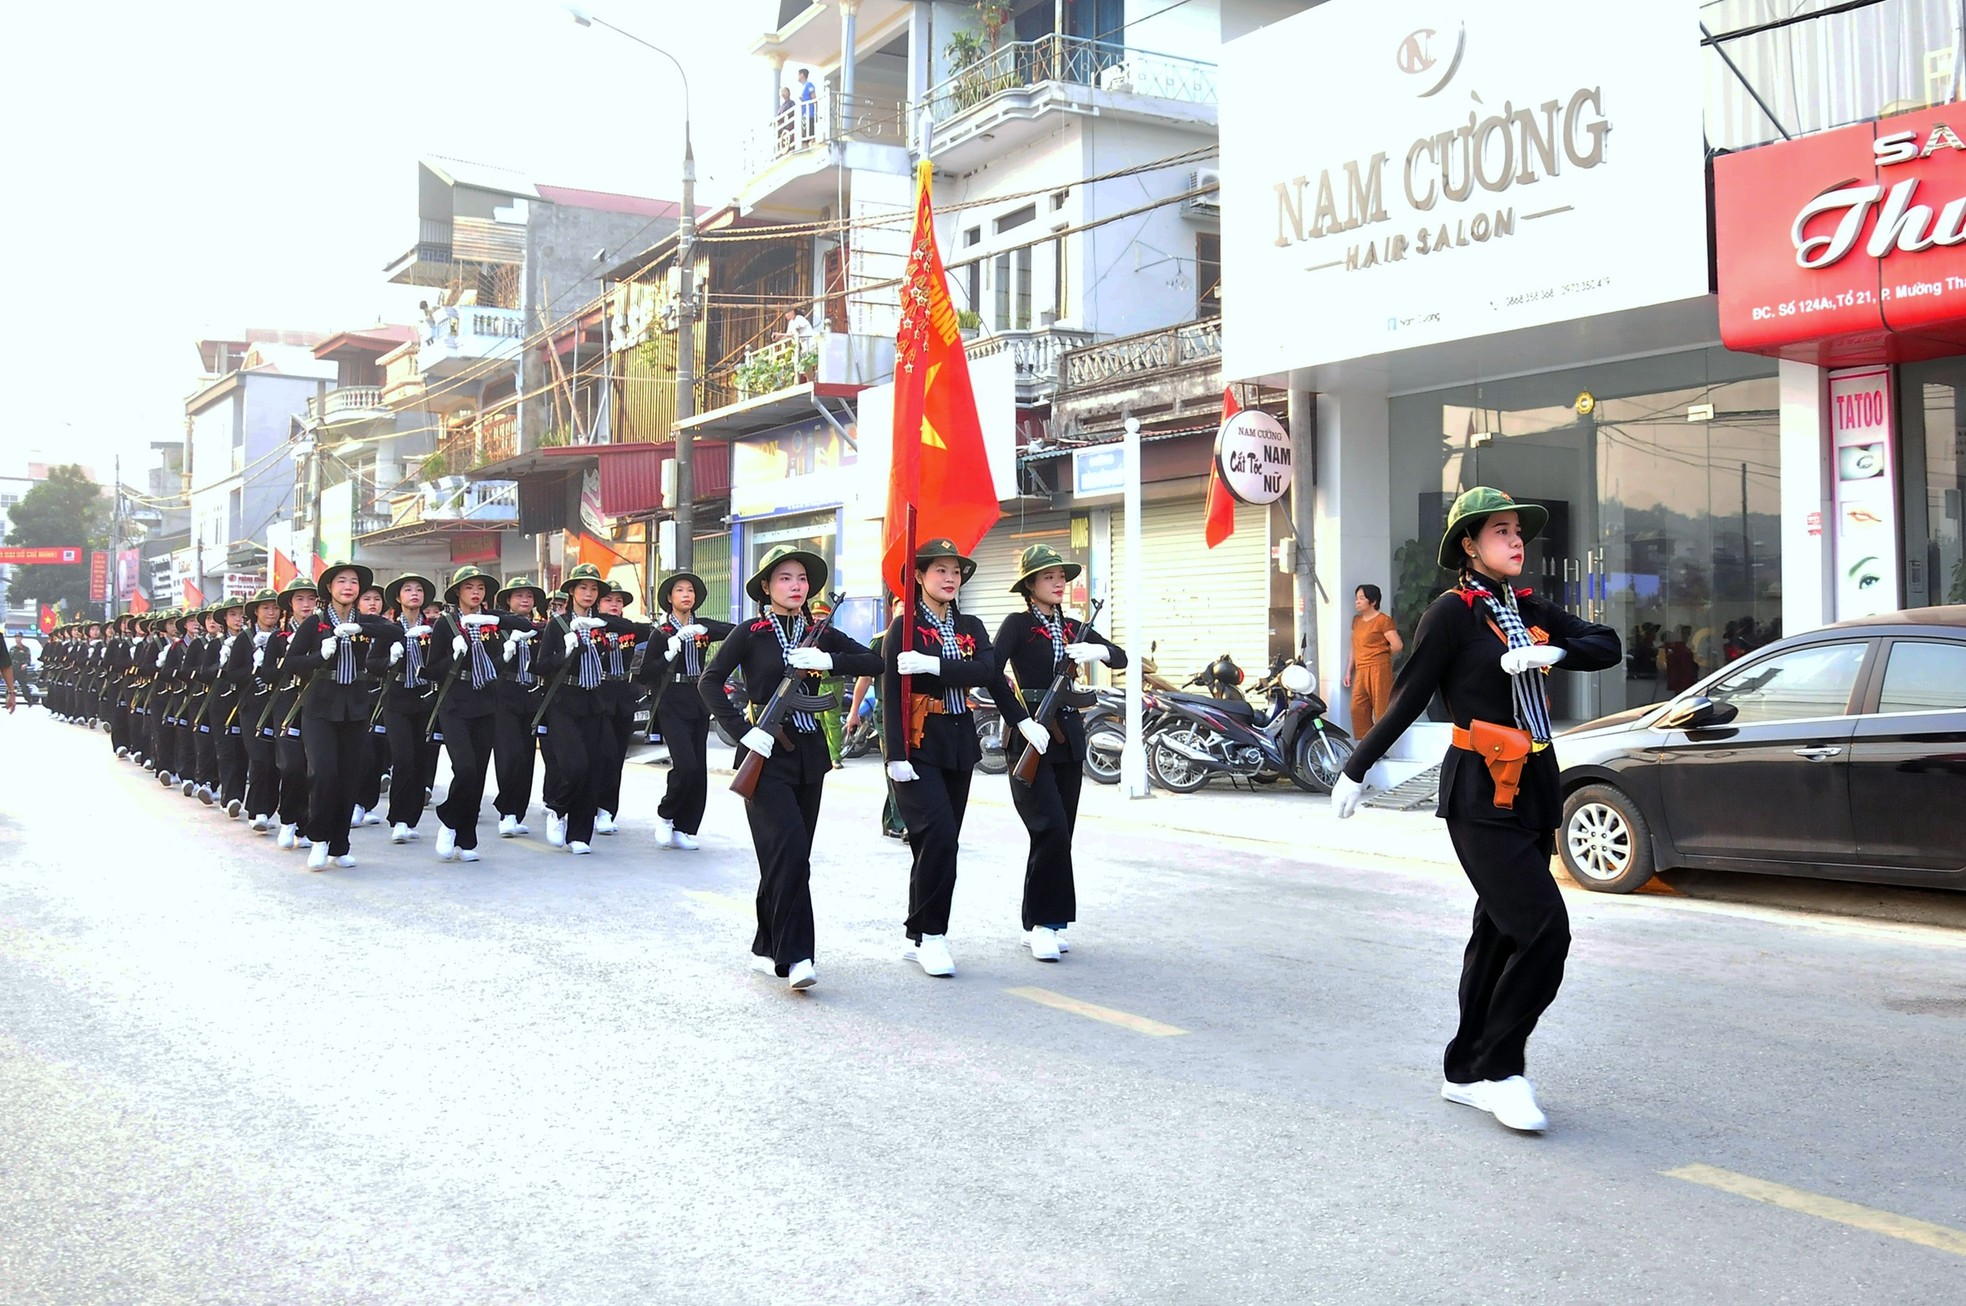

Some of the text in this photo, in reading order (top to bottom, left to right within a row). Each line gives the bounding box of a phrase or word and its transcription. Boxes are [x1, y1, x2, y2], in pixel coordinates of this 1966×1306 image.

[1273, 85, 1613, 248] NAM CƯỜNG
[1345, 207, 1516, 272] HAIR SALON
[1752, 306, 1775, 321] ĐC.
[1778, 300, 1796, 317] Số
[1836, 289, 1854, 307] Tổ
[1896, 281, 1943, 299] Mường
[1836, 389, 1884, 431] TATOO
[1238, 427, 1282, 441] NAM CƯỜNG
[1264, 445, 1291, 466] NAM
[1263, 471, 1282, 493] NỮ
